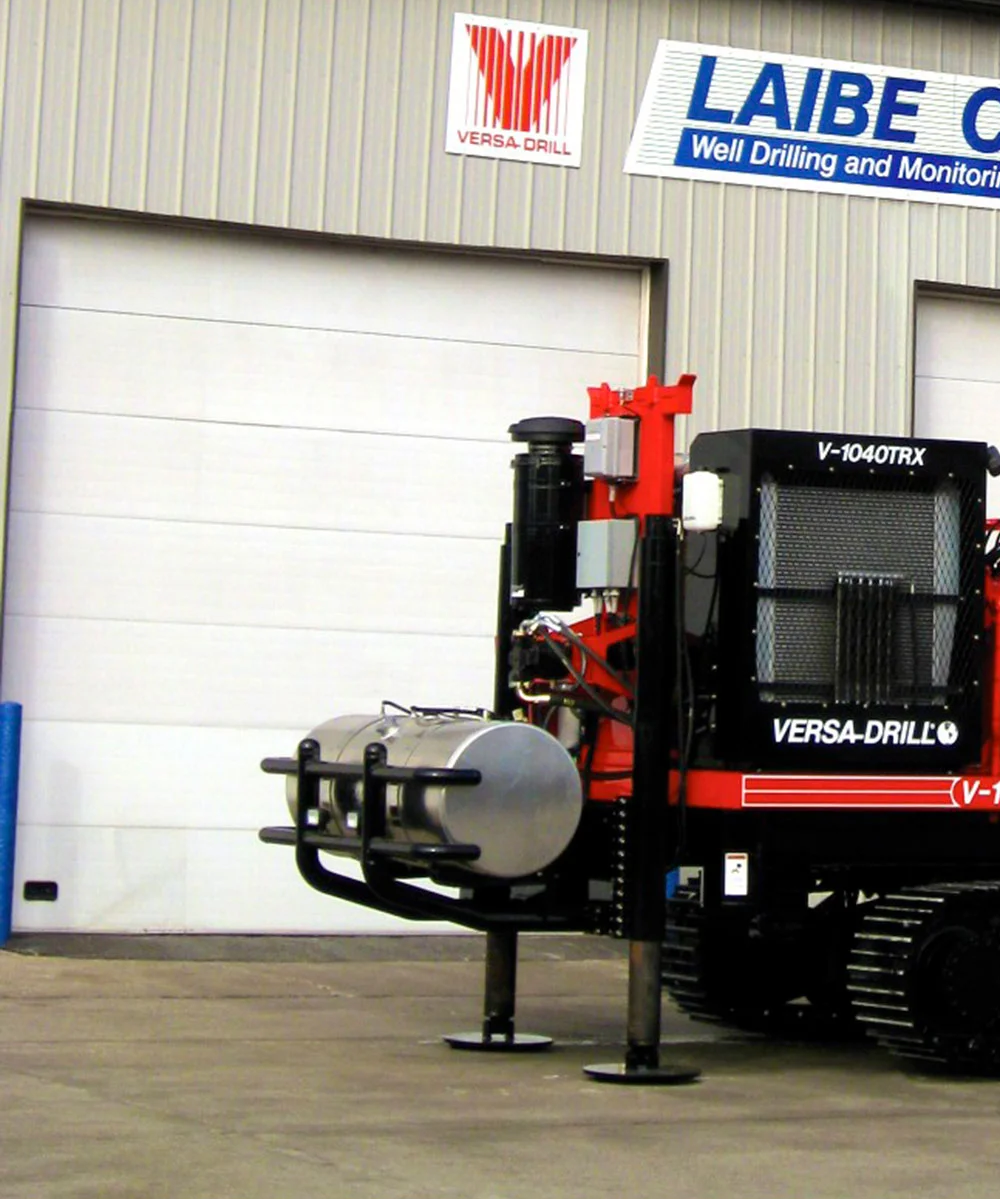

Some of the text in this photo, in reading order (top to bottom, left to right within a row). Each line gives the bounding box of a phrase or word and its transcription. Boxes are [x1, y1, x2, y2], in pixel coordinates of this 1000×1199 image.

[686, 56, 927, 143] LAIBE
[457, 130, 572, 156] VERSA-DRILL
[691, 134, 744, 163] Well
[749, 140, 837, 177] Drilling
[844, 154, 892, 178] and
[818, 441, 926, 466] V-1040TRX
[773, 719, 937, 744] VERSA-DRILL
